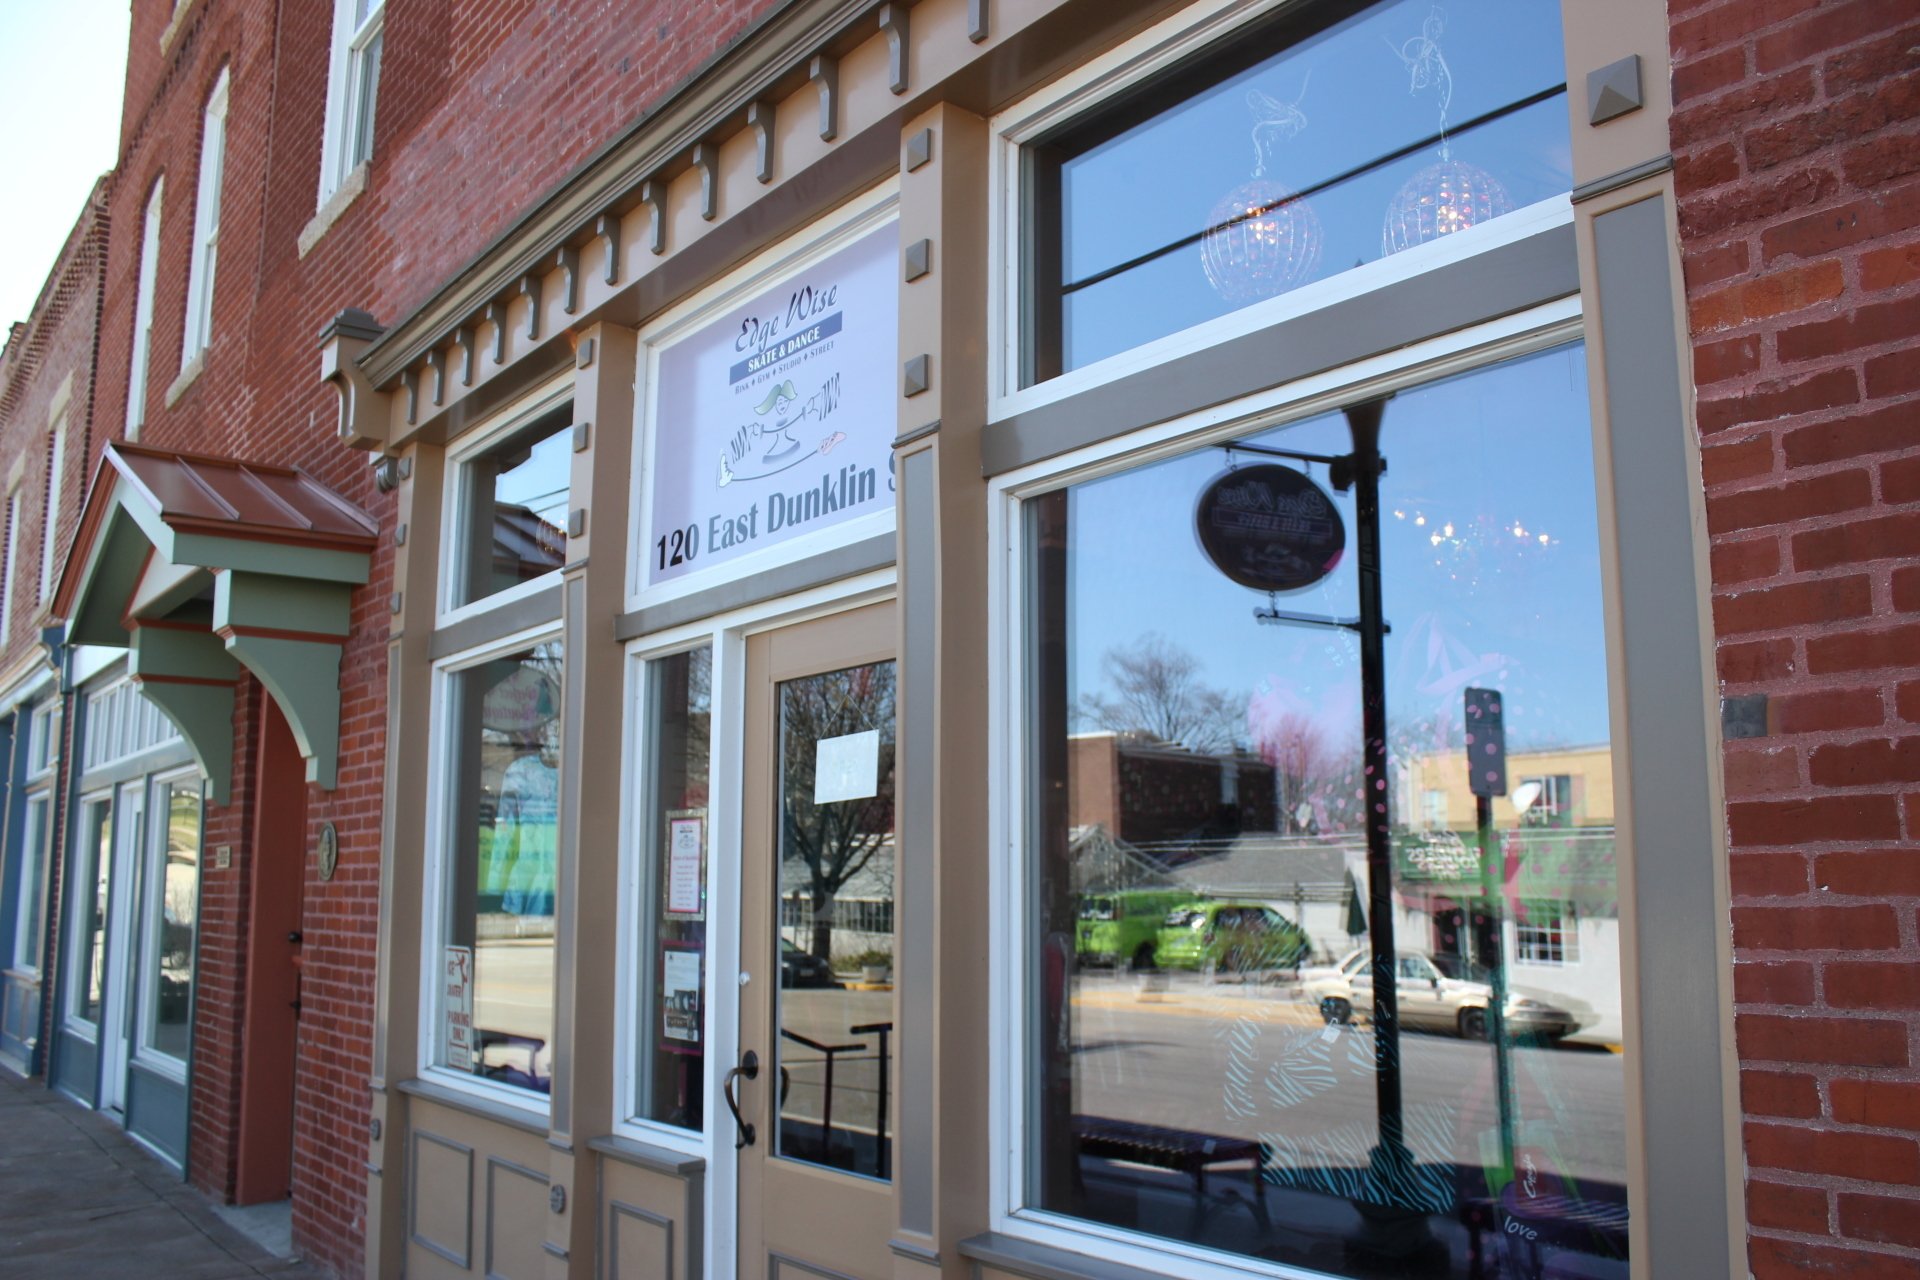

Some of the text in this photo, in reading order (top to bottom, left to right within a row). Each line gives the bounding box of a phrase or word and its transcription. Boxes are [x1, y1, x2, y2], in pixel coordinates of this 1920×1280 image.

[735, 285, 837, 352] Edge Wise
[748, 326, 820, 372] SKATE & DANCE
[778, 357, 802, 374] STUDIO
[810, 340, 834, 357] STREET
[656, 523, 699, 571] 120
[707, 501, 759, 554] East
[767, 463, 877, 534] Dunklin
[1504, 1215, 1538, 1240] love
